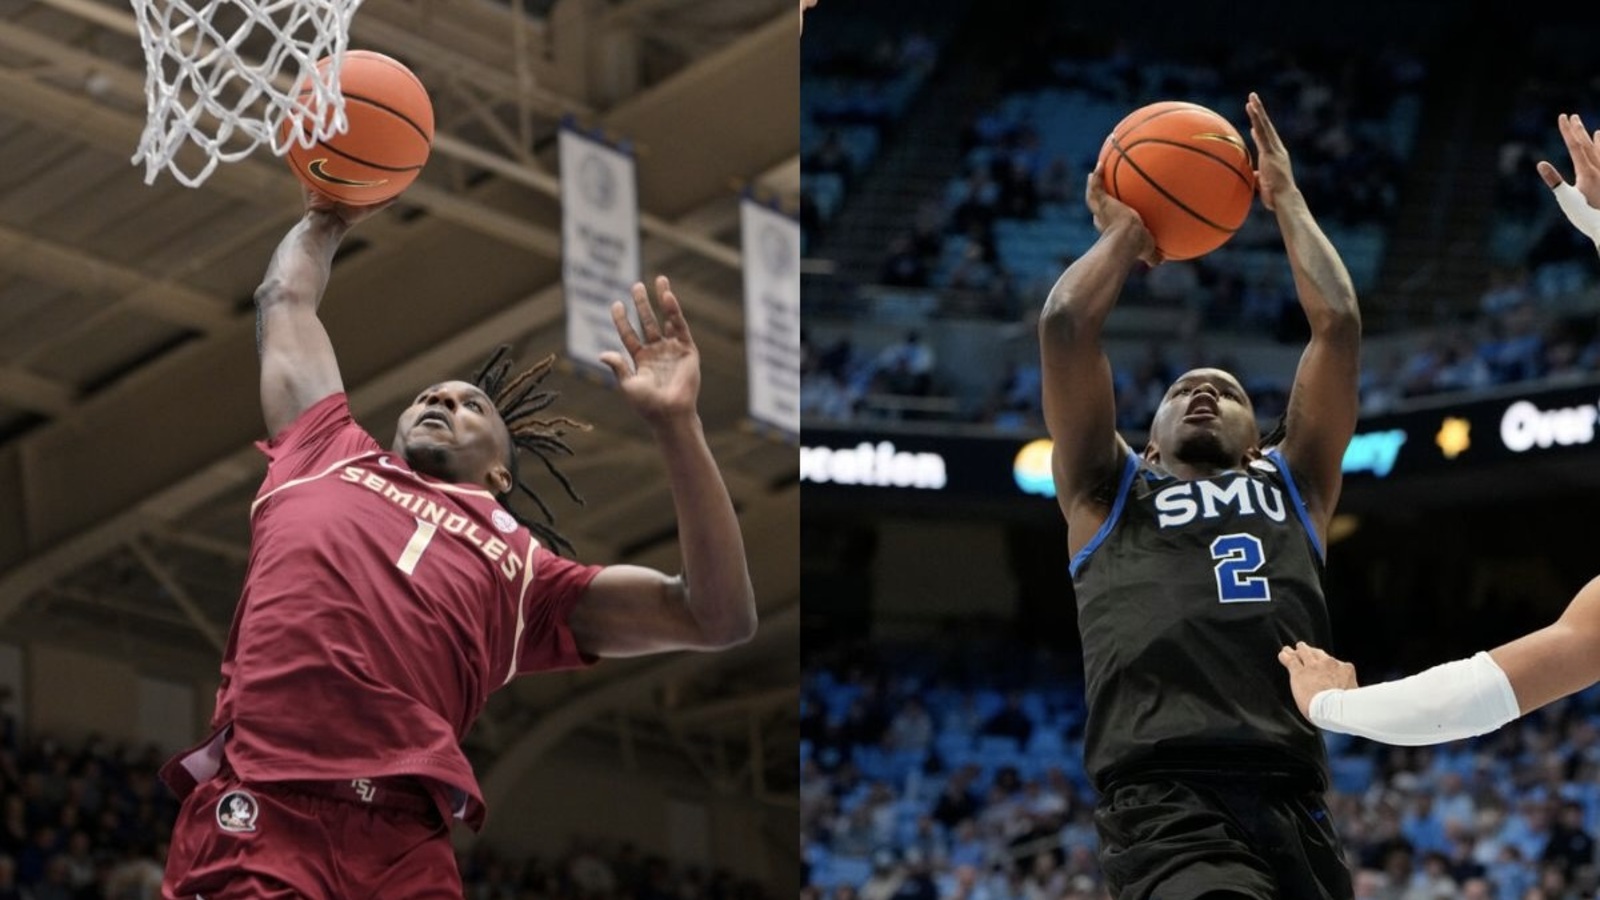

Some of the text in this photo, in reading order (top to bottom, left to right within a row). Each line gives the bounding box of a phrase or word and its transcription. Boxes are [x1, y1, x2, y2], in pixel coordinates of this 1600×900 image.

[340, 466, 523, 581] SEMINOLES
[1155, 477, 1286, 528] SMU
[396, 517, 438, 575] 1
[1210, 532, 1271, 603] 2
